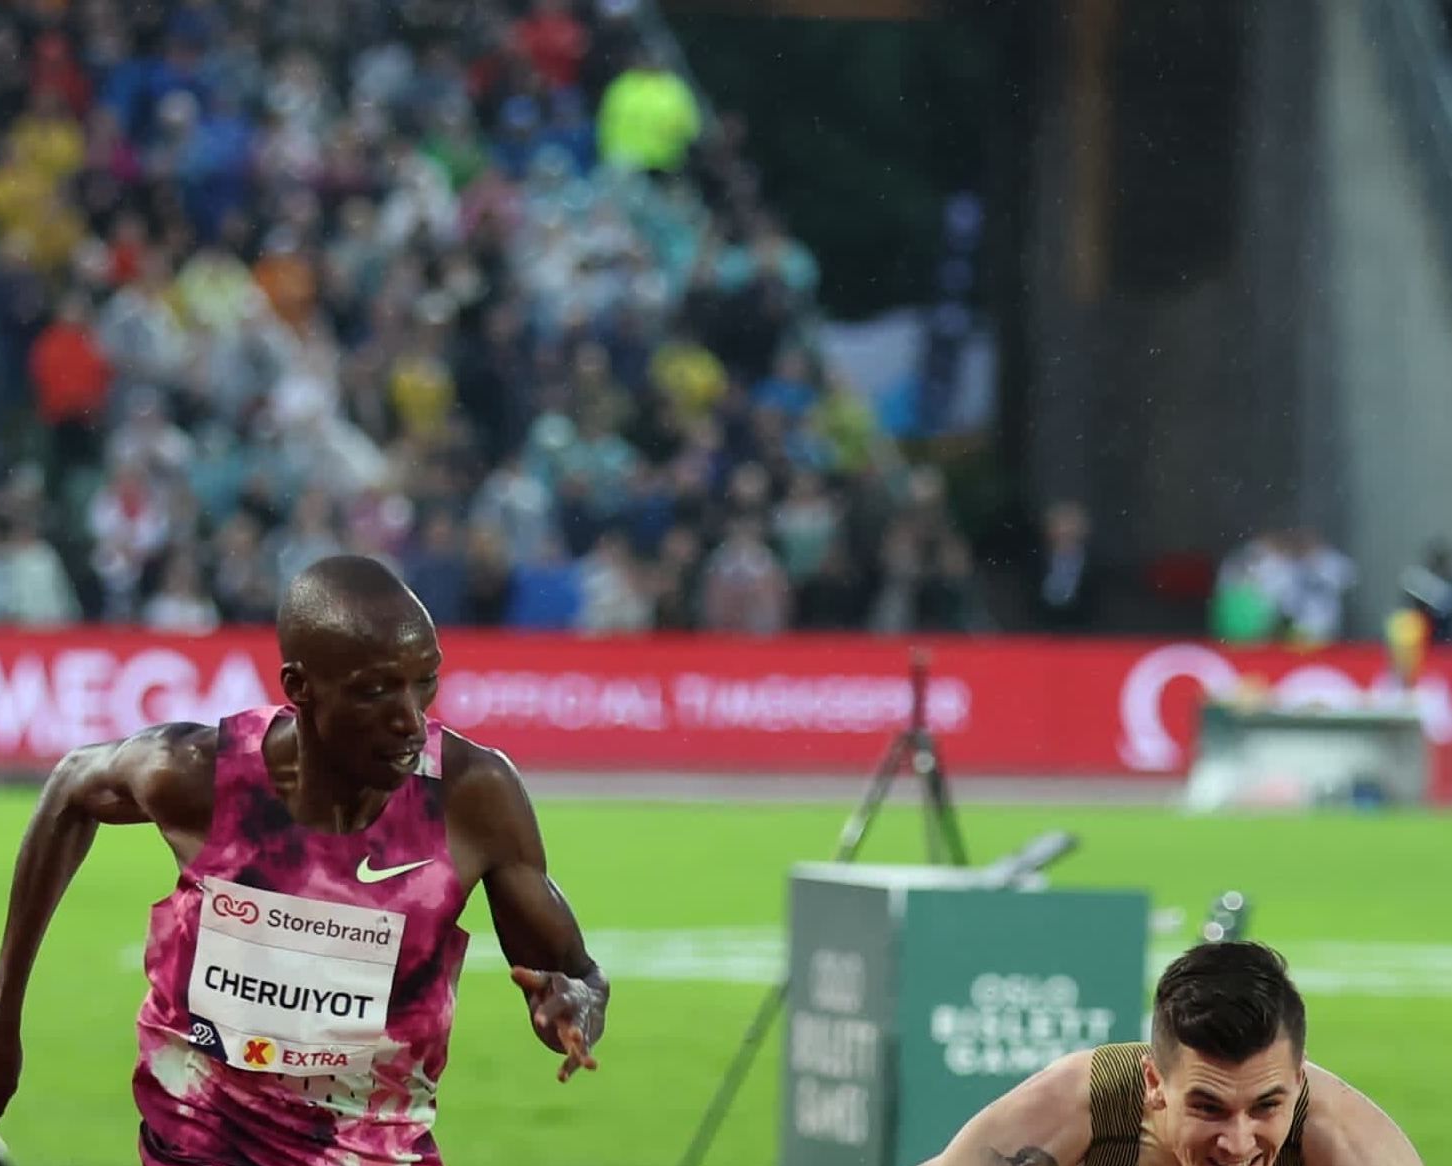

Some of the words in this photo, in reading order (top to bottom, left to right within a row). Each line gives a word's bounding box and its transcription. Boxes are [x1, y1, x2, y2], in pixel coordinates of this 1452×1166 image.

[266, 908, 392, 946] Storebrand
[204, 964, 375, 1020] CHERUIYOT
[281, 1048, 350, 1067] EXTRA
